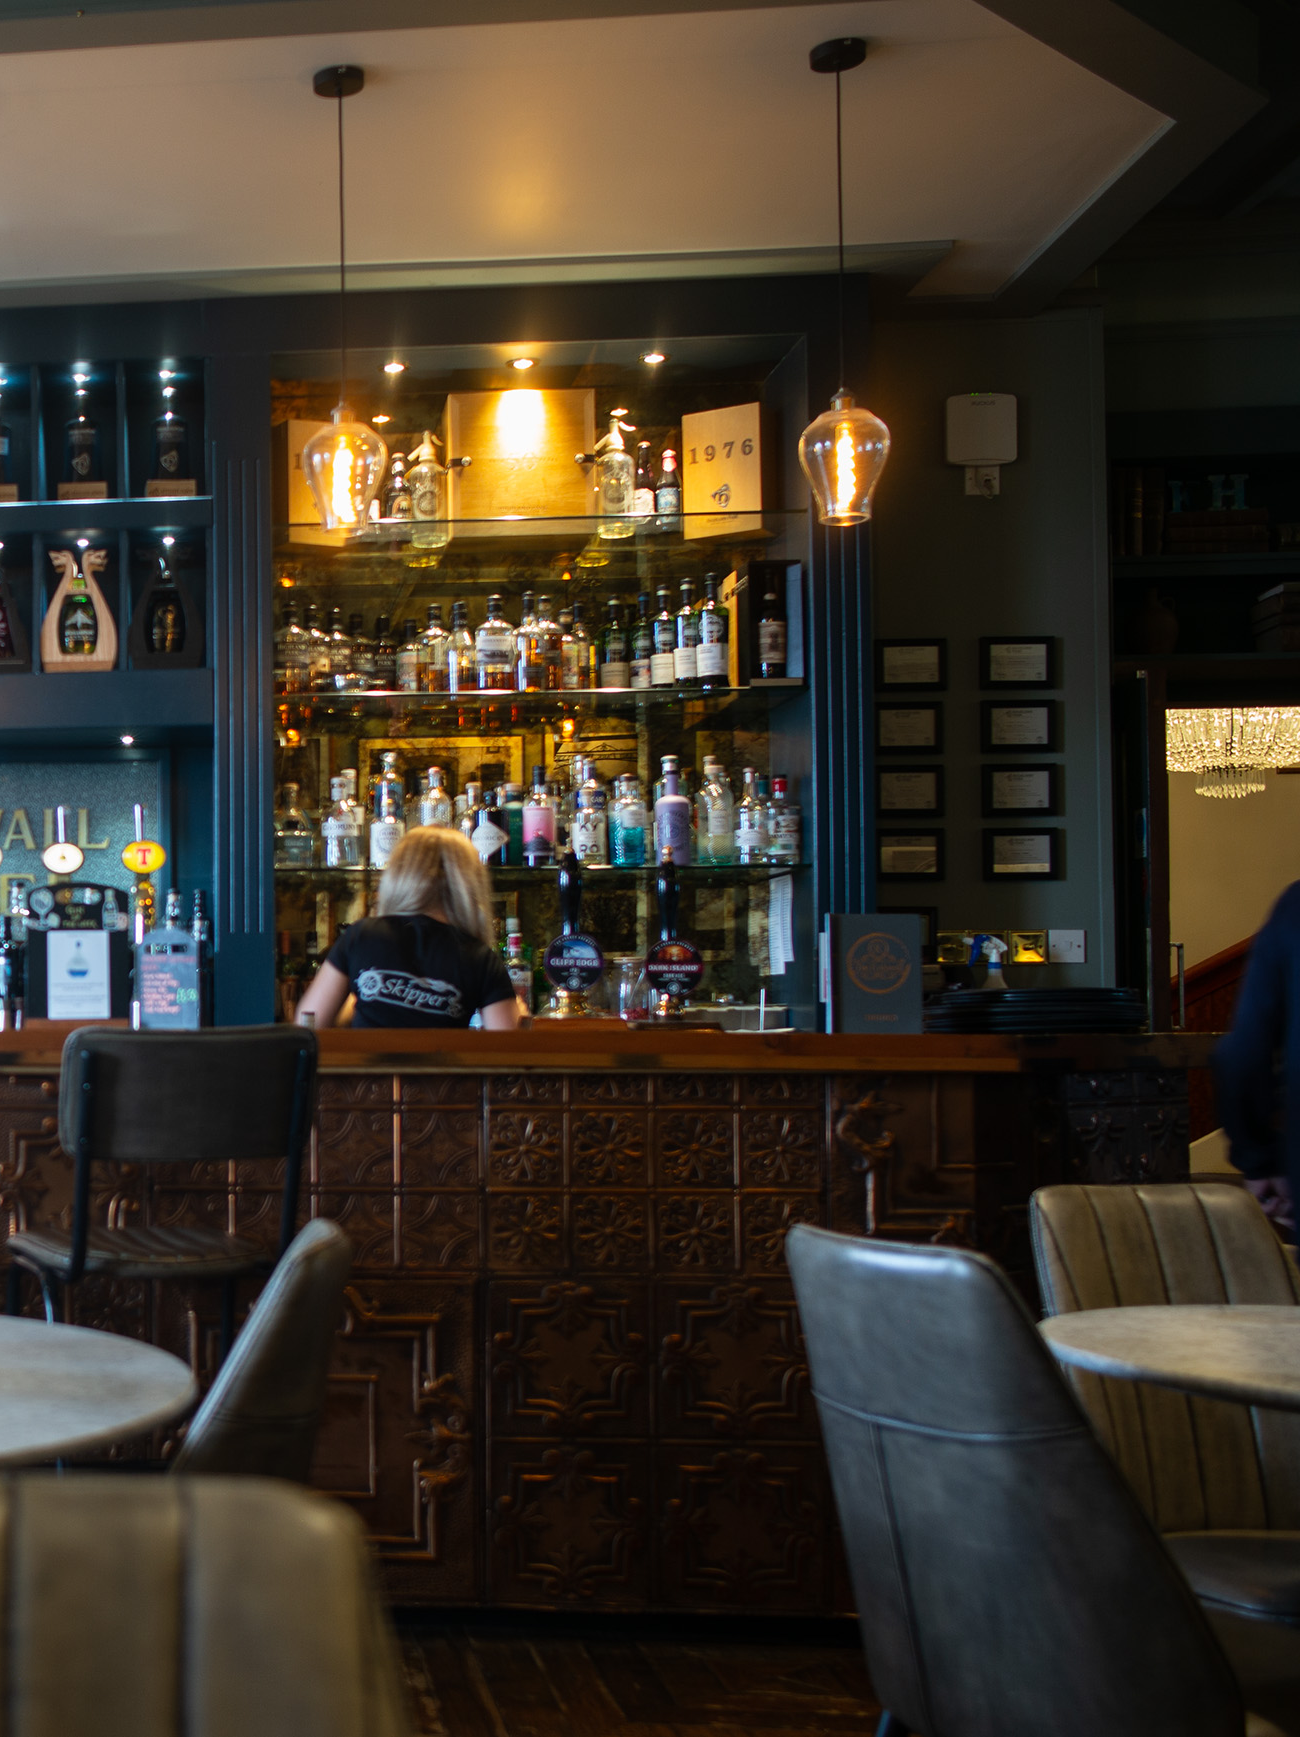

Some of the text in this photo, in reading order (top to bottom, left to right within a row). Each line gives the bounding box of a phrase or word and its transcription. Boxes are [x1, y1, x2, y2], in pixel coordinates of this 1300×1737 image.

[688, 438, 754, 466] 1976
[136, 848, 151, 865] T
[576, 958, 599, 967] EDGE
